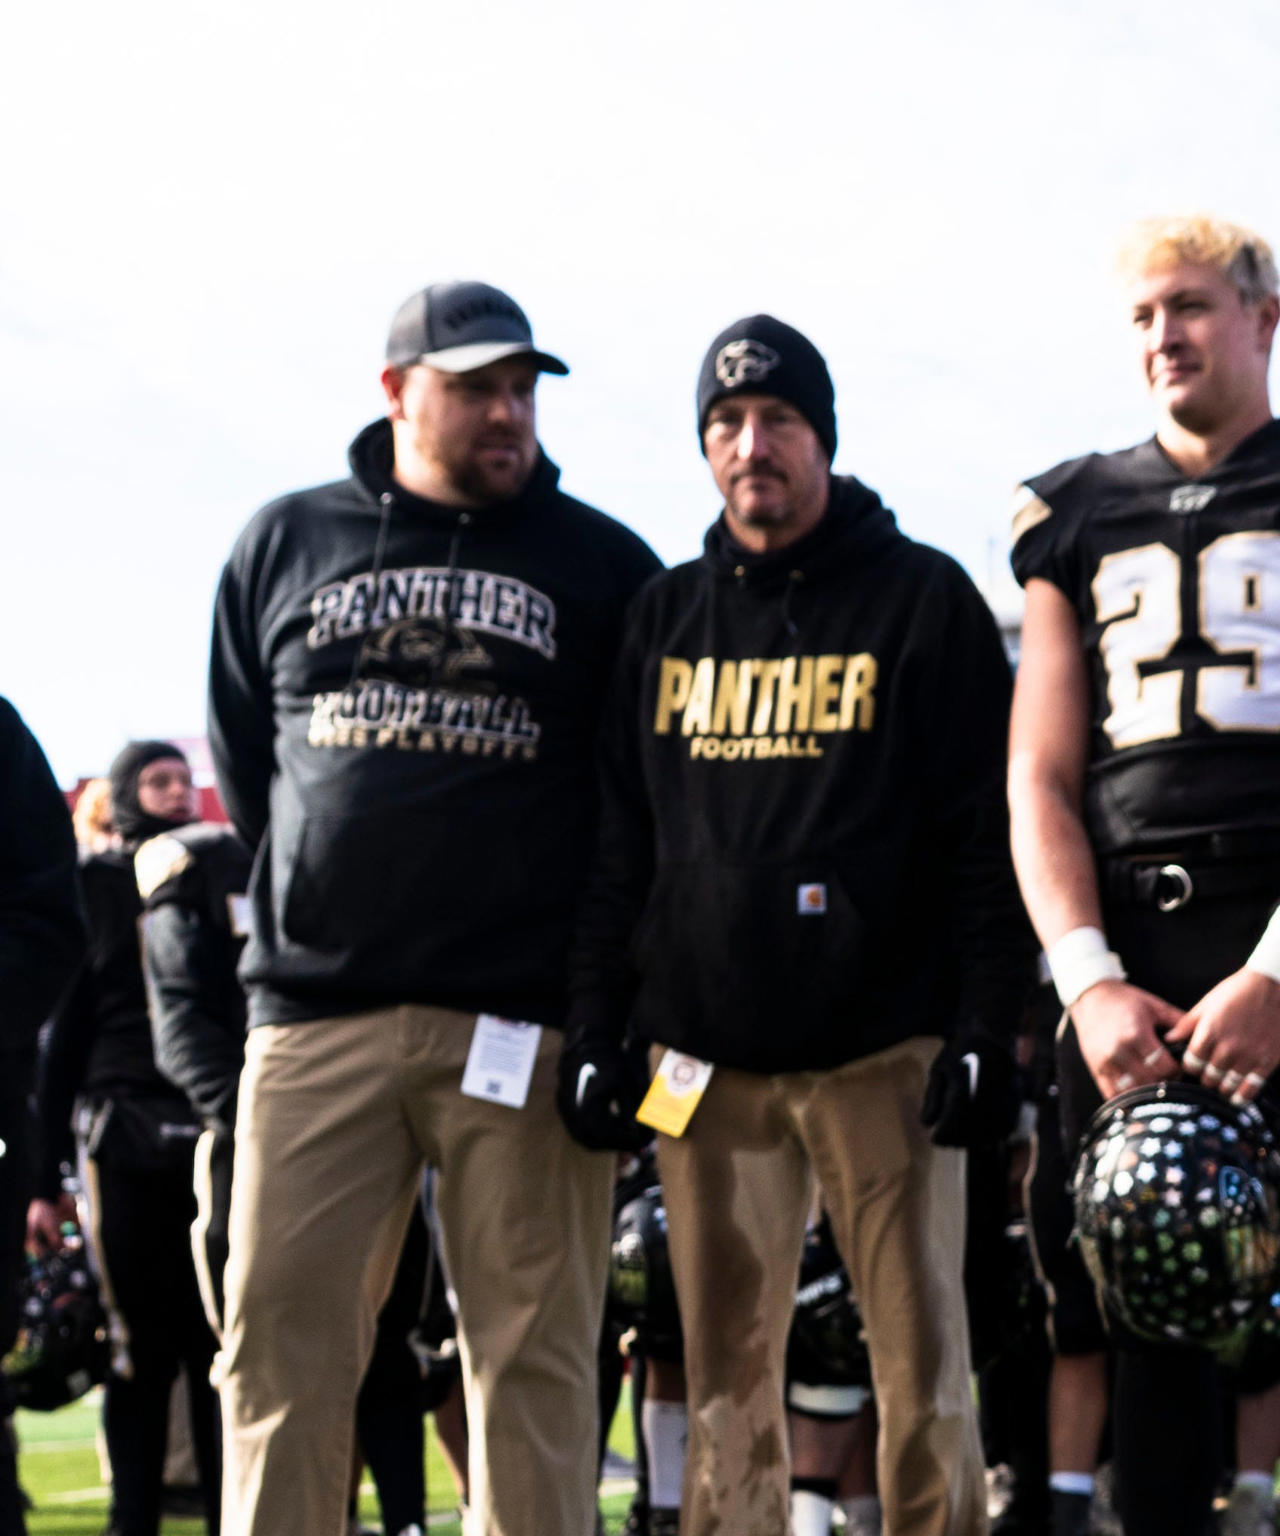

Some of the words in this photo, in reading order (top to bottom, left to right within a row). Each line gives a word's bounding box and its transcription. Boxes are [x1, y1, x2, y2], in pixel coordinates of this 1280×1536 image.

[307, 566, 557, 660] PANTHER
[654, 652, 878, 736] PANTHER
[690, 735, 824, 761] FOOTBALL
